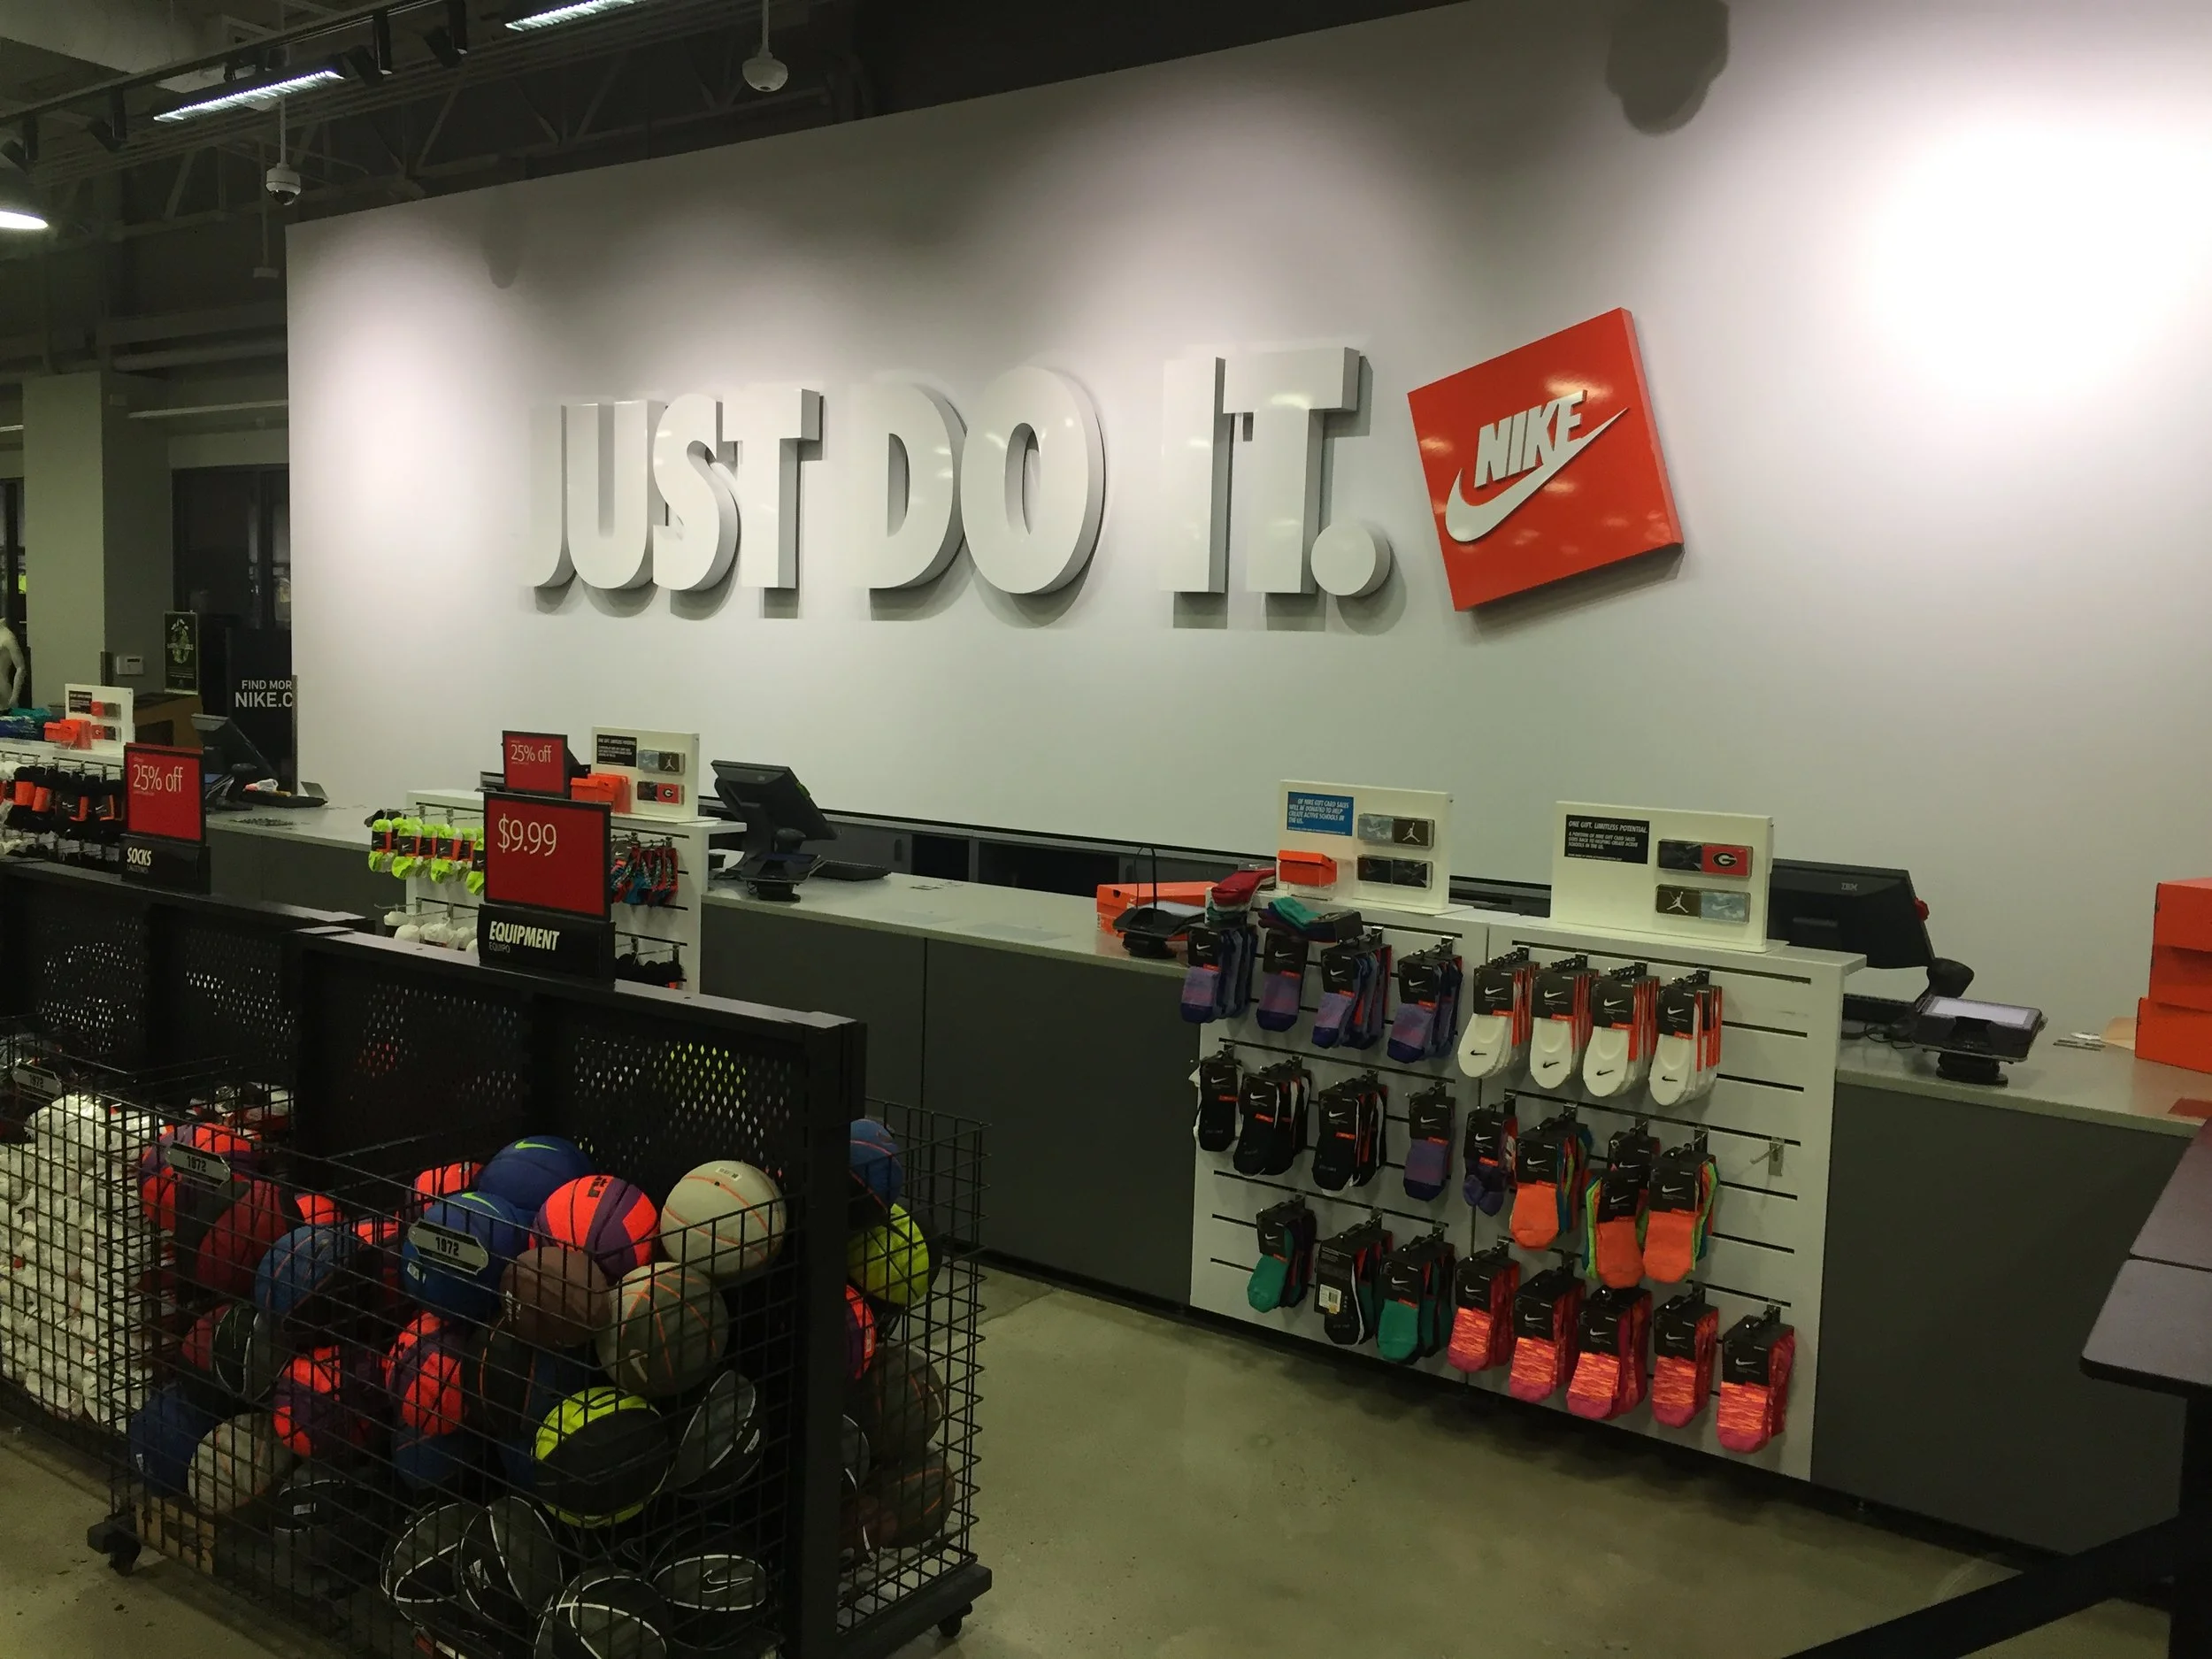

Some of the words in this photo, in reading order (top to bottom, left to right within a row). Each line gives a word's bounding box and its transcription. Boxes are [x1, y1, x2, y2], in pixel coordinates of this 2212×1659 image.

[1474, 389, 1588, 488] NIKE
[529, 387, 819, 591] JUST
[852, 366, 1103, 594] DO
[1160, 347, 1390, 597] IT.
[242, 680, 266, 690] FIND
[269, 680, 292, 690] MOR
[234, 692, 293, 708] NIKE.C
[511, 744, 535, 762] 25%
[538, 745, 552, 763] off
[133, 764, 163, 791] 25%
[165, 766, 183, 792] off
[497, 813, 557, 856] $9.99
[1594, 822, 1619, 831] LIMITLESS
[127, 847, 152, 866] SOCKS
[488, 920, 560, 951] EQUIPMENT
